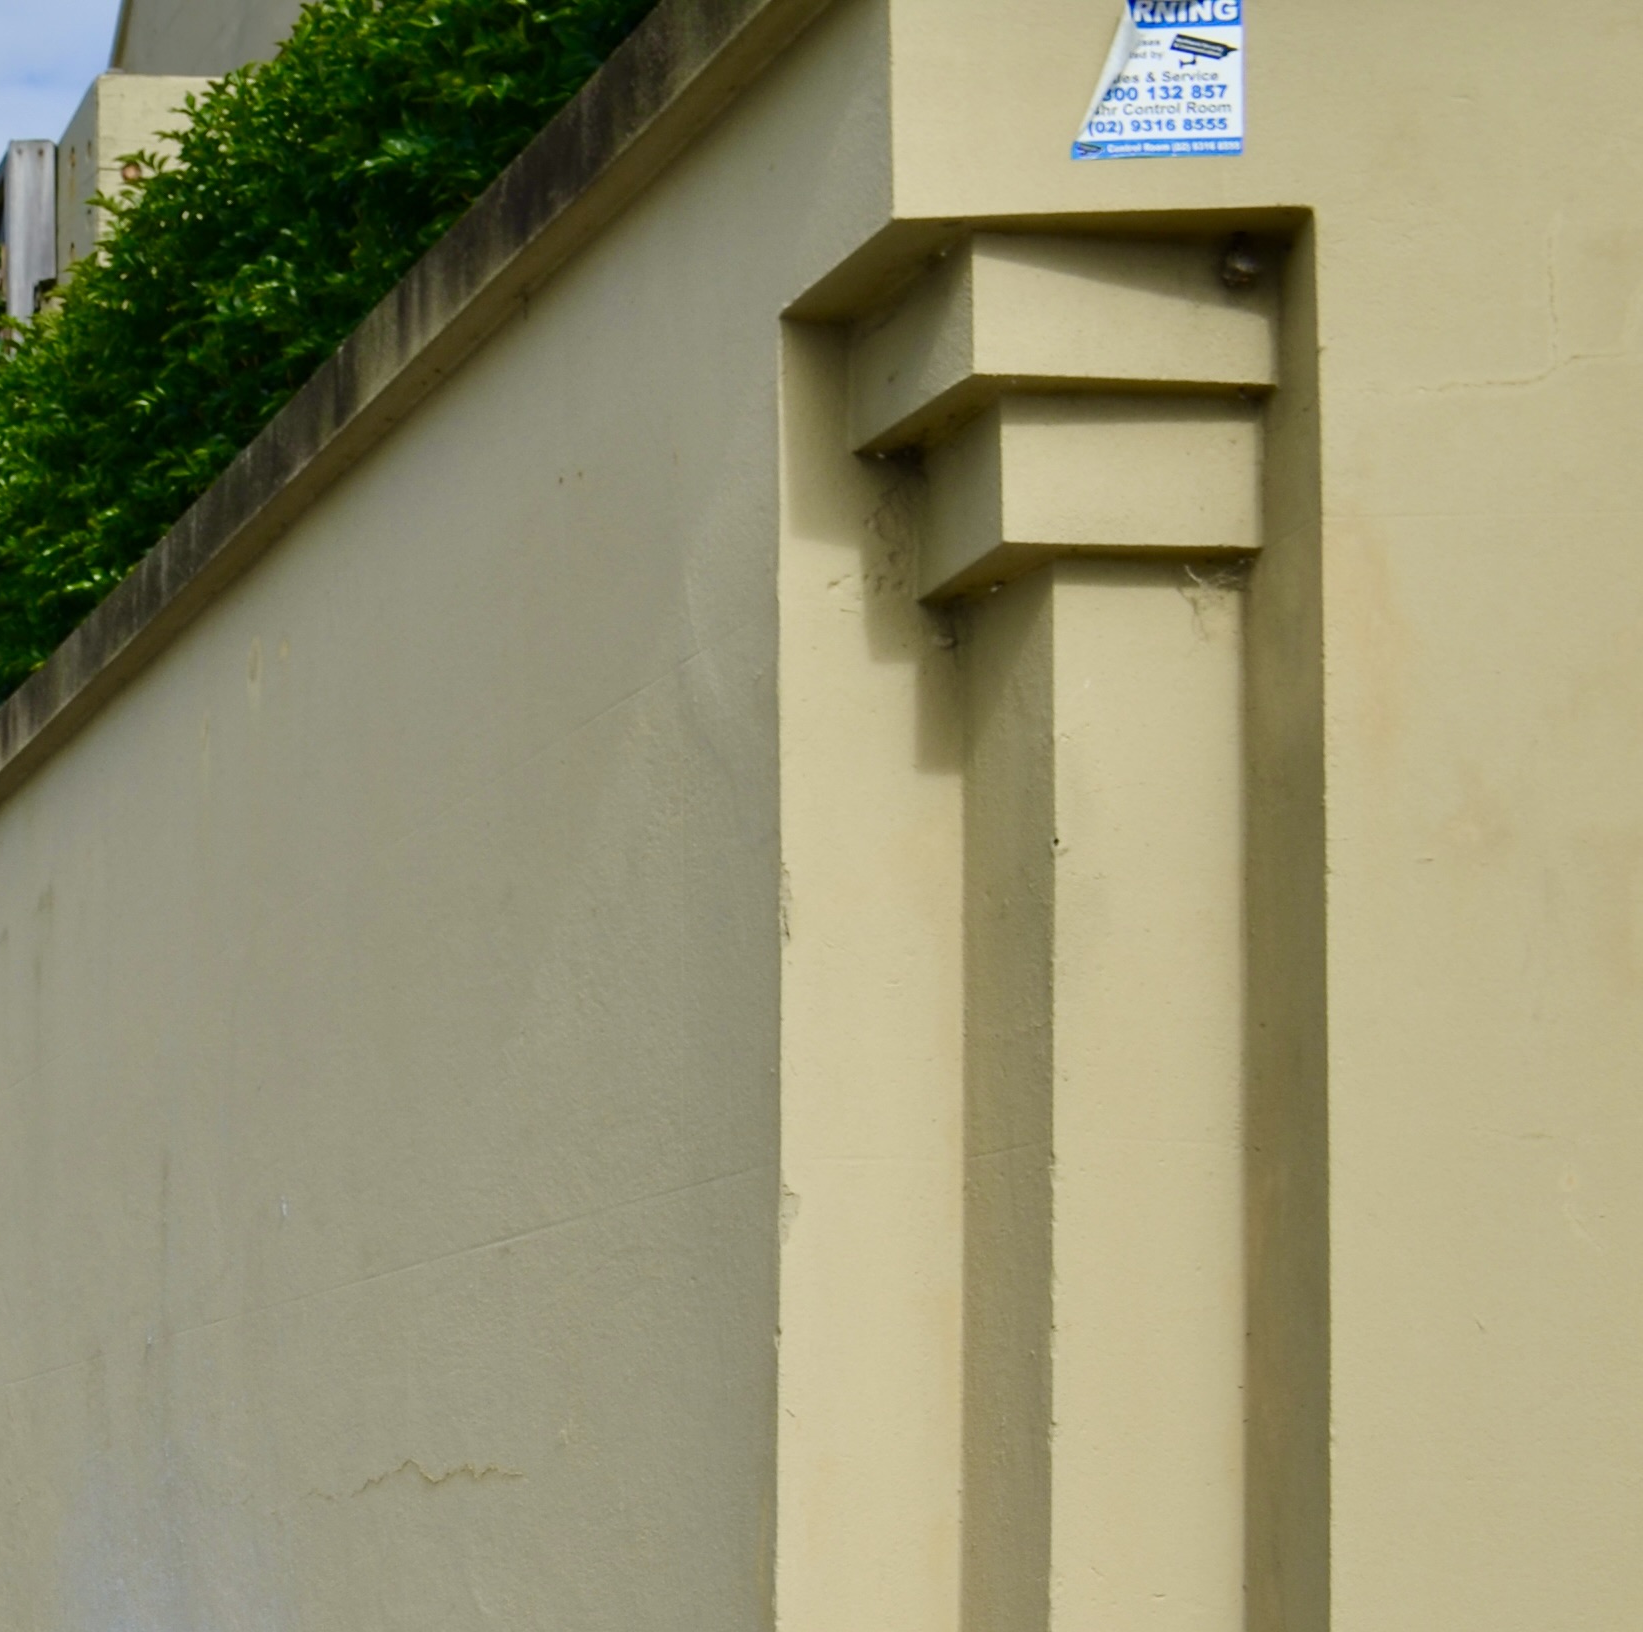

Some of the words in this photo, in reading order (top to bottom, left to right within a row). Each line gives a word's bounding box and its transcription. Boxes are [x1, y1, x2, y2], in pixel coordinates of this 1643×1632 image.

[1146, 72, 1157, 83] &
[1162, 71, 1219, 82] Service
[1147, 86, 1184, 99] 132
[1192, 84, 1227, 98] 857
[1123, 103, 1181, 115] Control
[1187, 102, 1232, 114] Room
[1087, 120, 1124, 136] (02)
[1131, 119, 1176, 132] 9316
[1183, 118, 1228, 130] 8555
